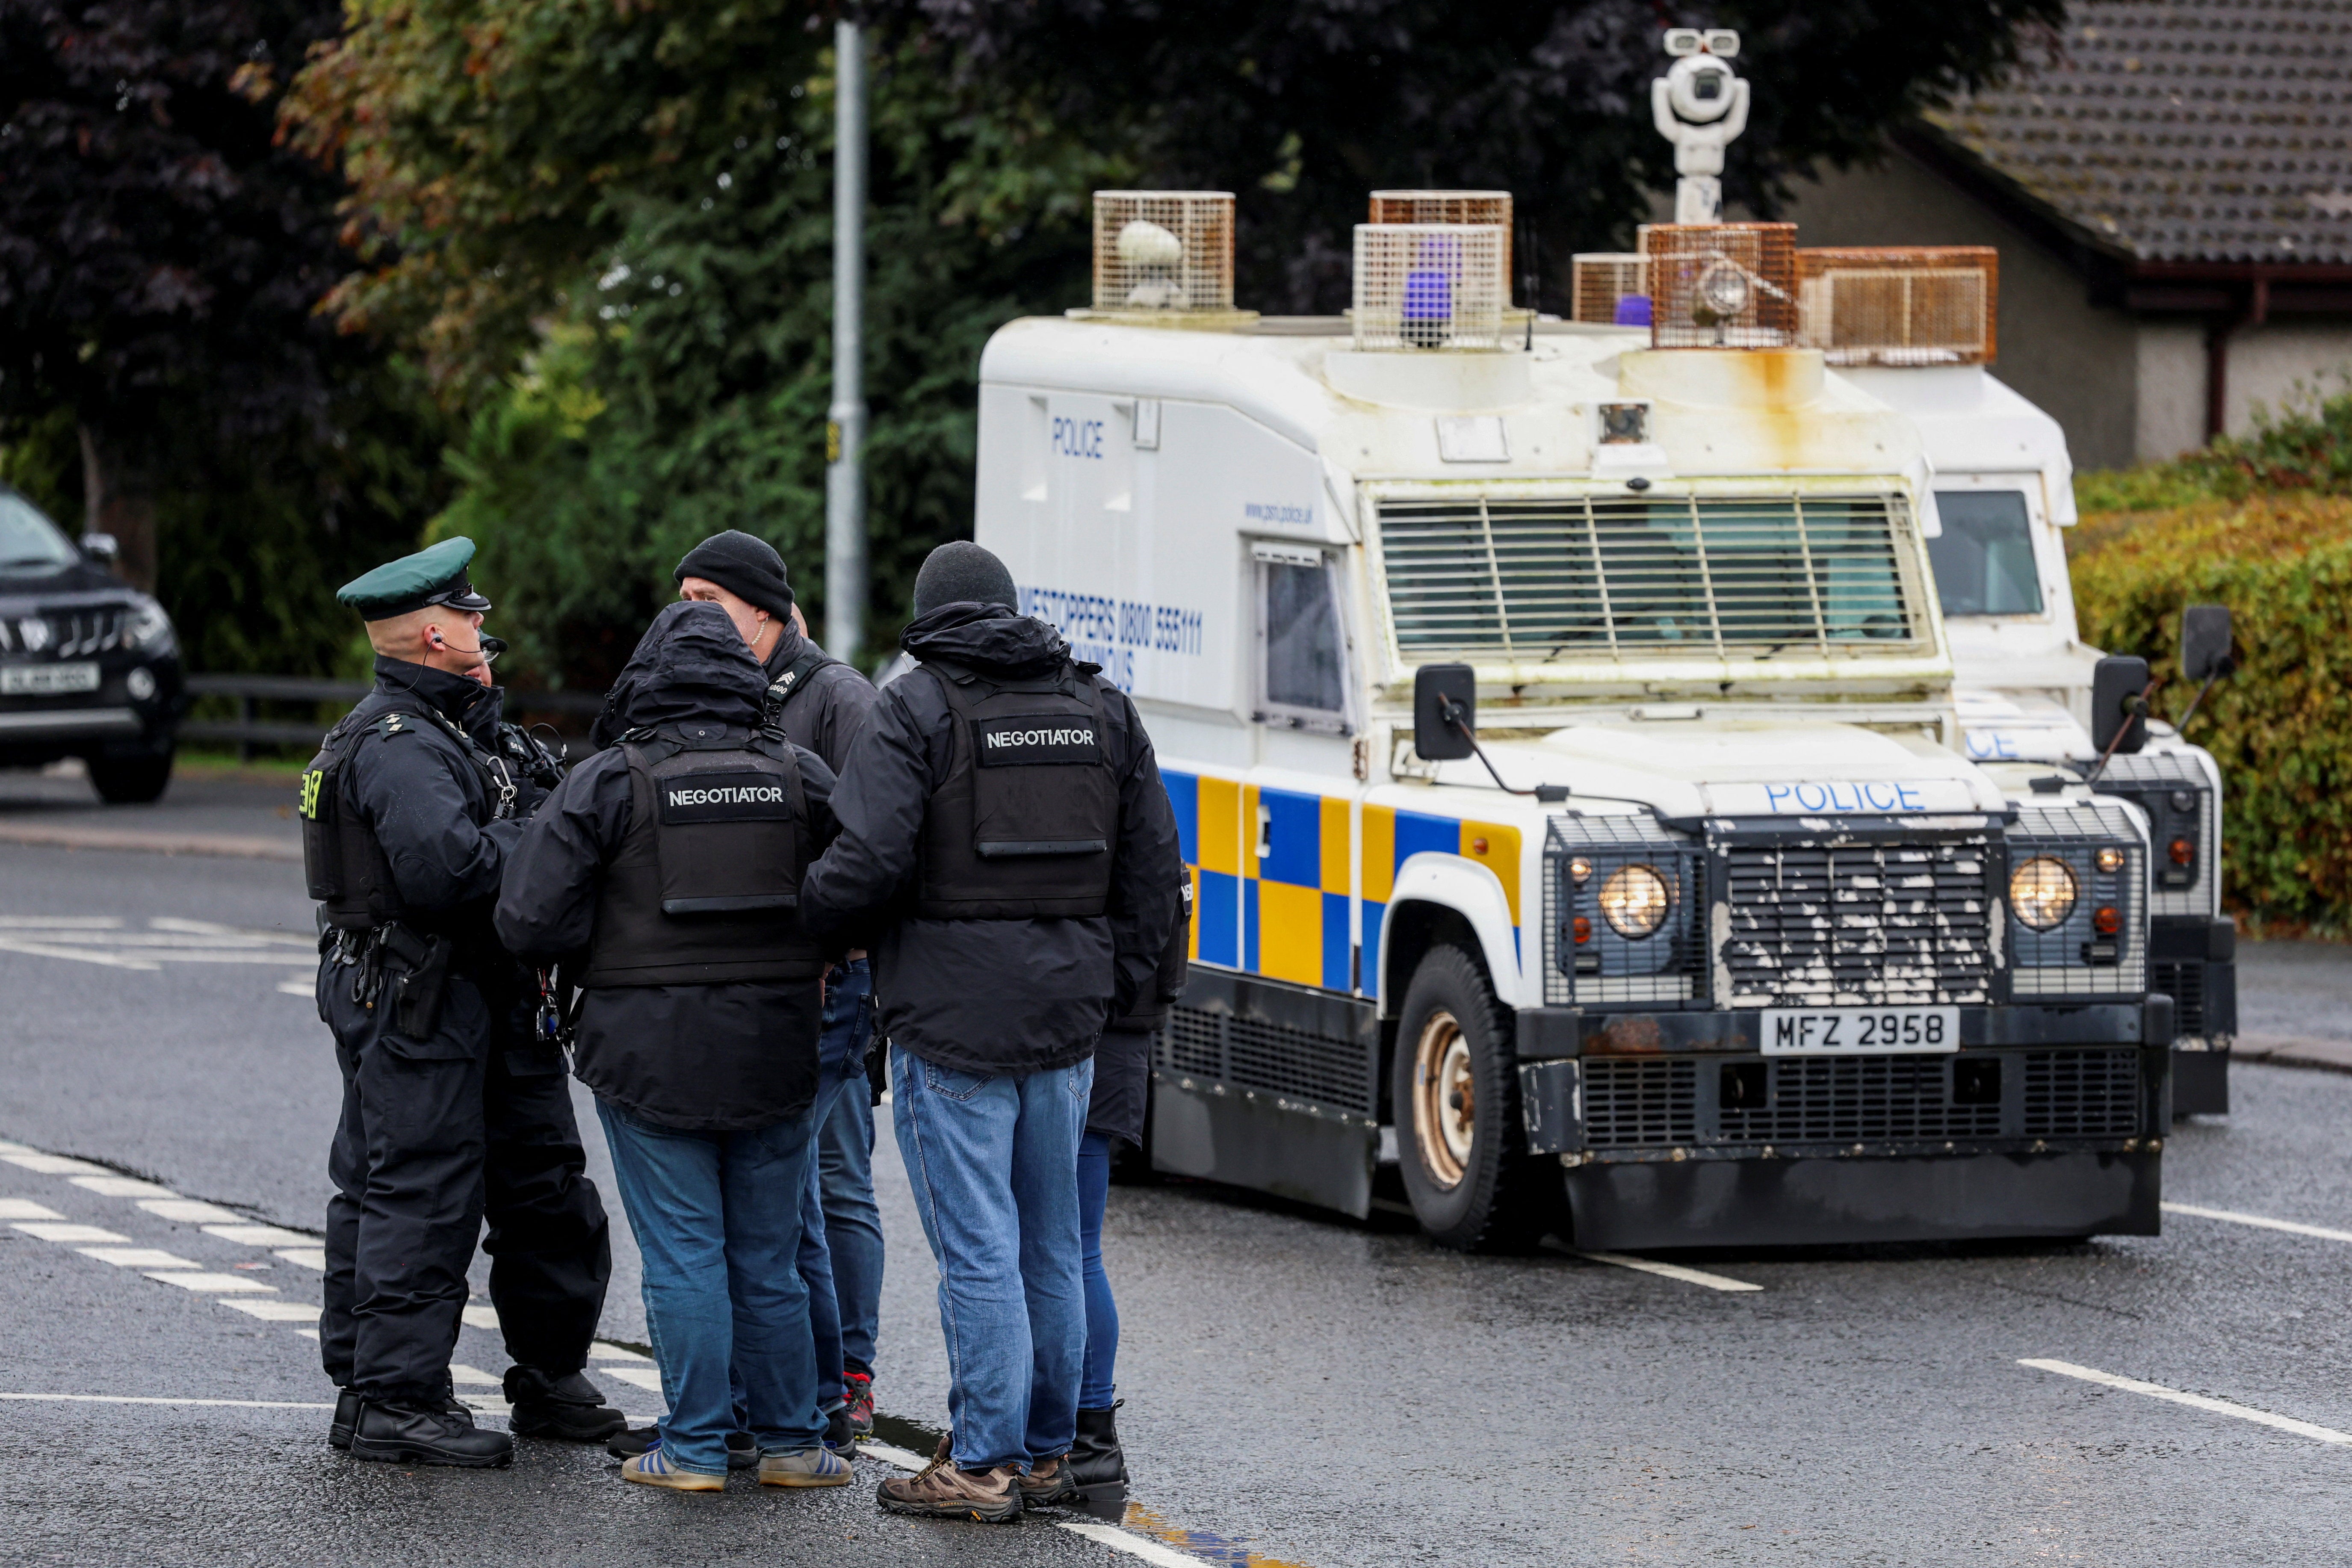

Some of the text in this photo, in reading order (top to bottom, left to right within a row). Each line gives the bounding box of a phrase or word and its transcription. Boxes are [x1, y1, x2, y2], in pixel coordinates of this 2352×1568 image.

[1052, 416, 1103, 459] POLICE
[1016, 585, 1202, 656] MESTOPPERS 0800 555111
[987, 729, 1094, 748] NEGOTIATOR
[1966, 730, 2020, 758] CE
[669, 787, 783, 806] NEGOTIATOR
[1765, 783, 1925, 813] POLICE
[1776, 1014, 1943, 1047] MFZ 2958
